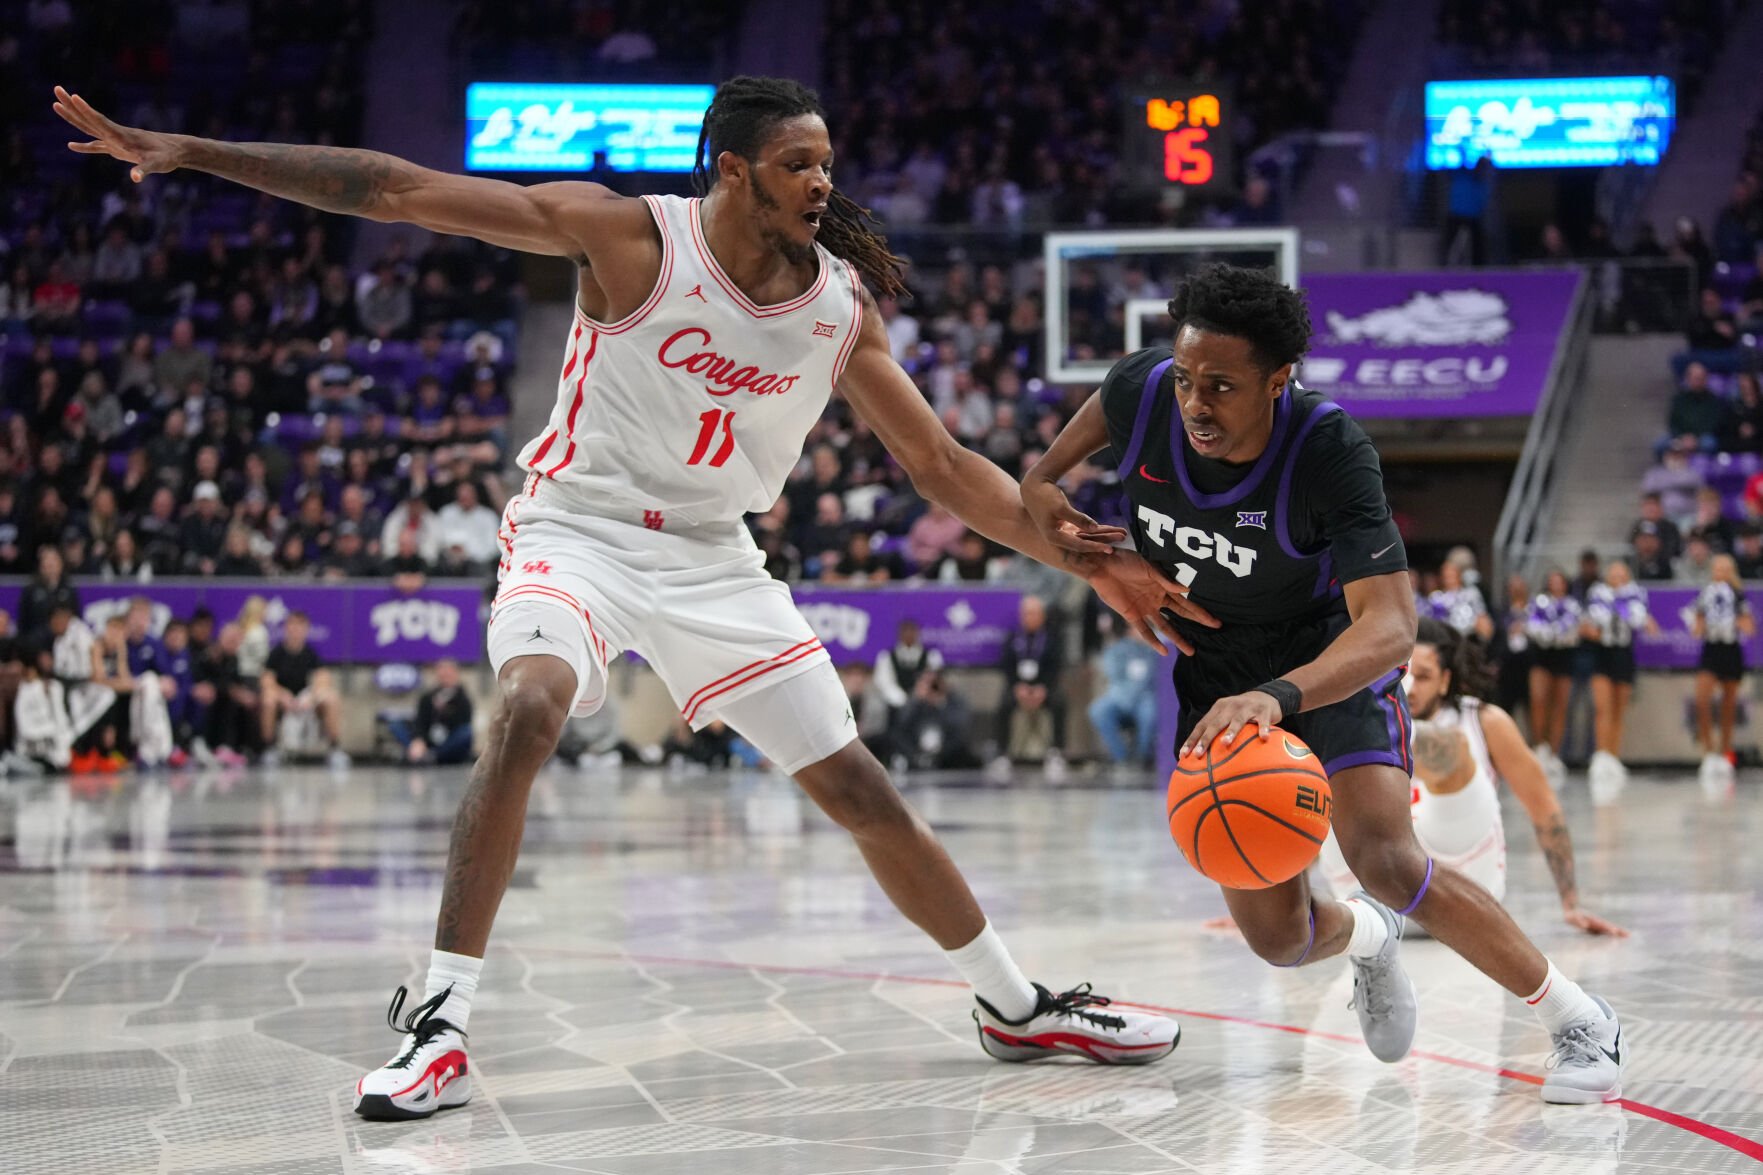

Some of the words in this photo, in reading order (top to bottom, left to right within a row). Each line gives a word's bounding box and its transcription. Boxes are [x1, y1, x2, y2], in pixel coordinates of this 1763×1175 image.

[1164, 128, 1213, 185] 15
[658, 327, 801, 396] Cougars
[1356, 357, 1508, 385] EECU
[687, 408, 736, 468] 11
[1138, 505, 1257, 578] TCU
[371, 600, 459, 647] TCU
[798, 603, 870, 650] CU
